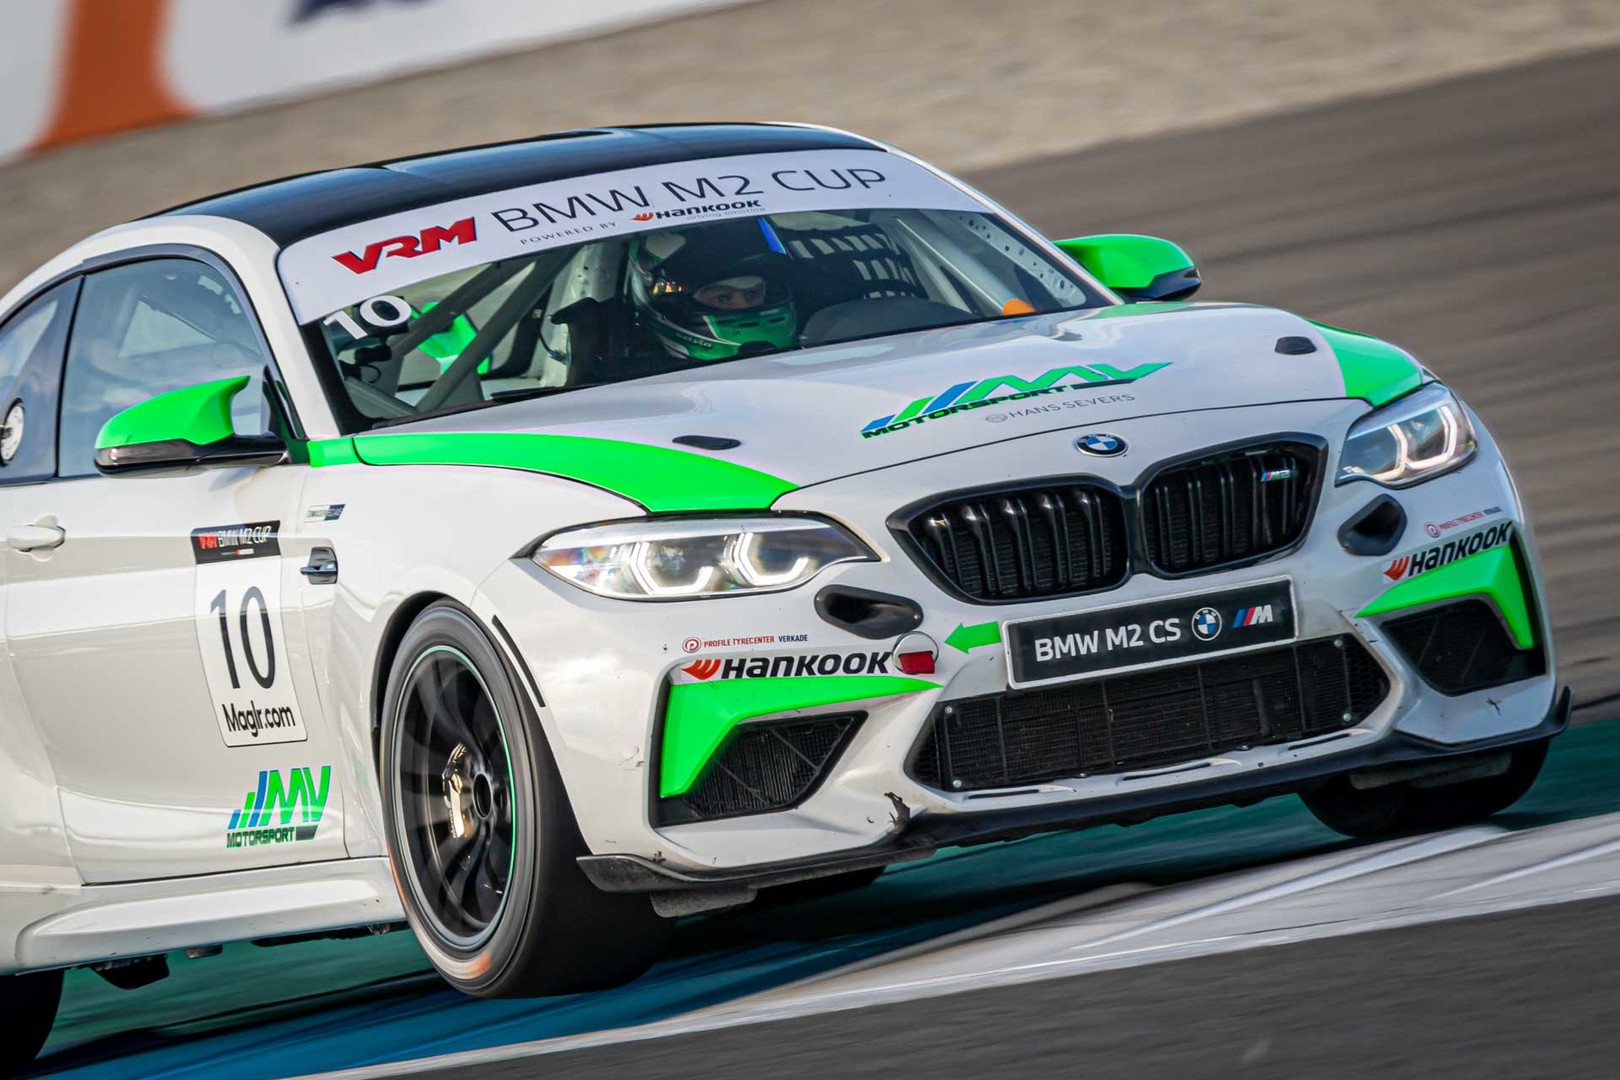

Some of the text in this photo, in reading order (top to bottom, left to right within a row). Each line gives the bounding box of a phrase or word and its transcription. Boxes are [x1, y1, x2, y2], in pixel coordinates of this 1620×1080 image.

[491, 168, 887, 233] BMW M2 CUP
[331, 216, 477, 275] VRM
[519, 220, 617, 246] POWERED BY
[322, 294, 412, 340] 10
[860, 384, 1066, 439] MOTORSPORT
[1009, 393, 1136, 420] HANS SEVERS
[253, 525, 272, 544] CUP
[209, 586, 276, 689] 10
[703, 633, 809, 649] PROFILE TYRECENTER VERKADE
[1034, 629, 1099, 663] BMW
[1105, 624, 1145, 652] M2
[1149, 617, 1182, 644] CS
[226, 824, 295, 849] MOTORSPORT
